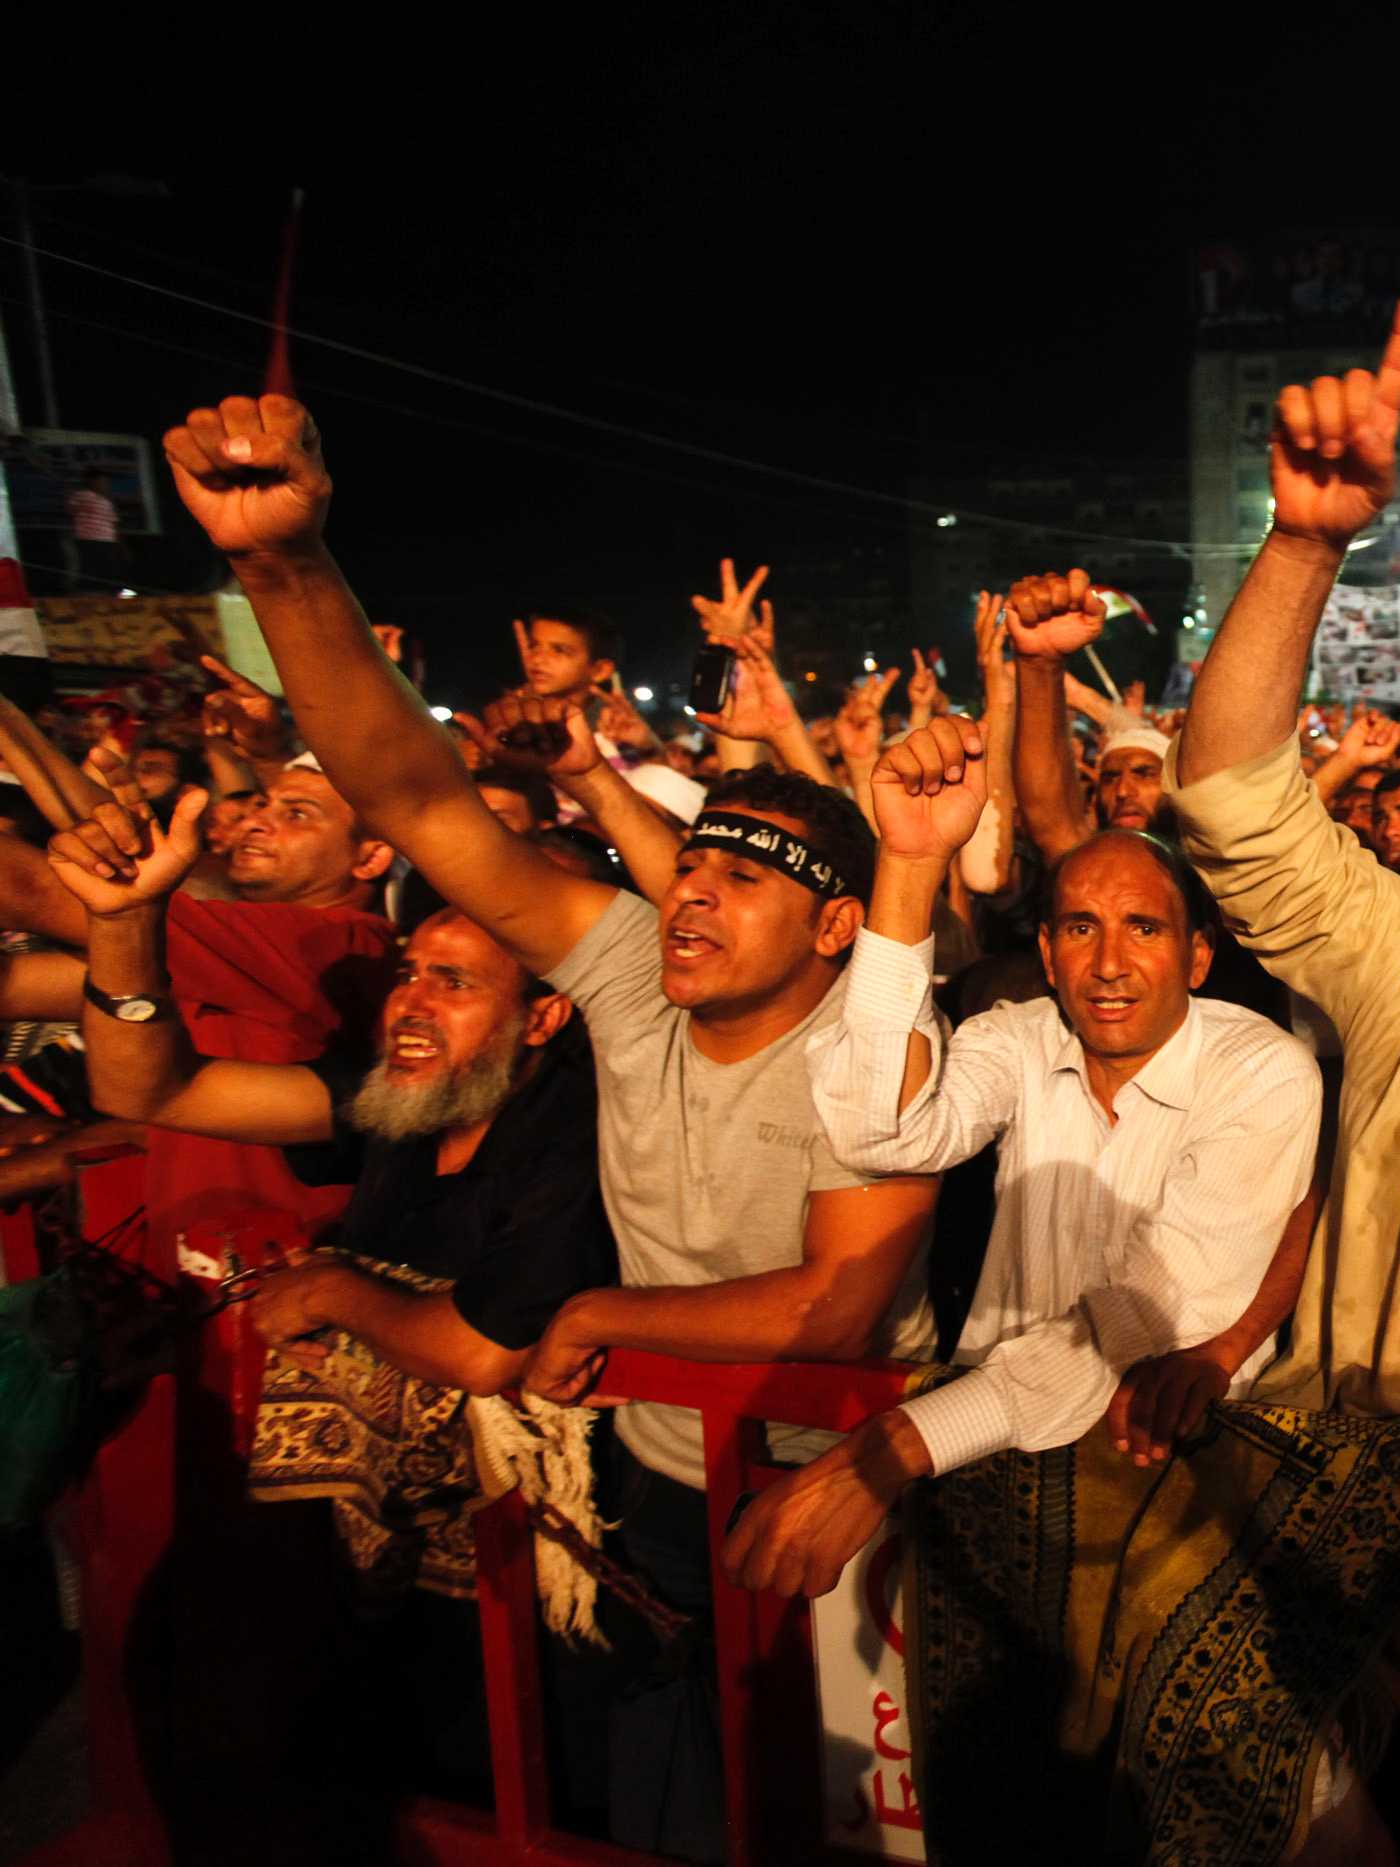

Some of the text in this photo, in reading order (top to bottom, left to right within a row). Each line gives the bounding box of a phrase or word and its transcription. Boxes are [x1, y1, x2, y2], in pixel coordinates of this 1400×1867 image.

[697, 822, 742, 839] محمد
[745, 828, 781, 852] الله
[784, 841, 808, 871] إلا
[833, 876, 846, 895] لا
